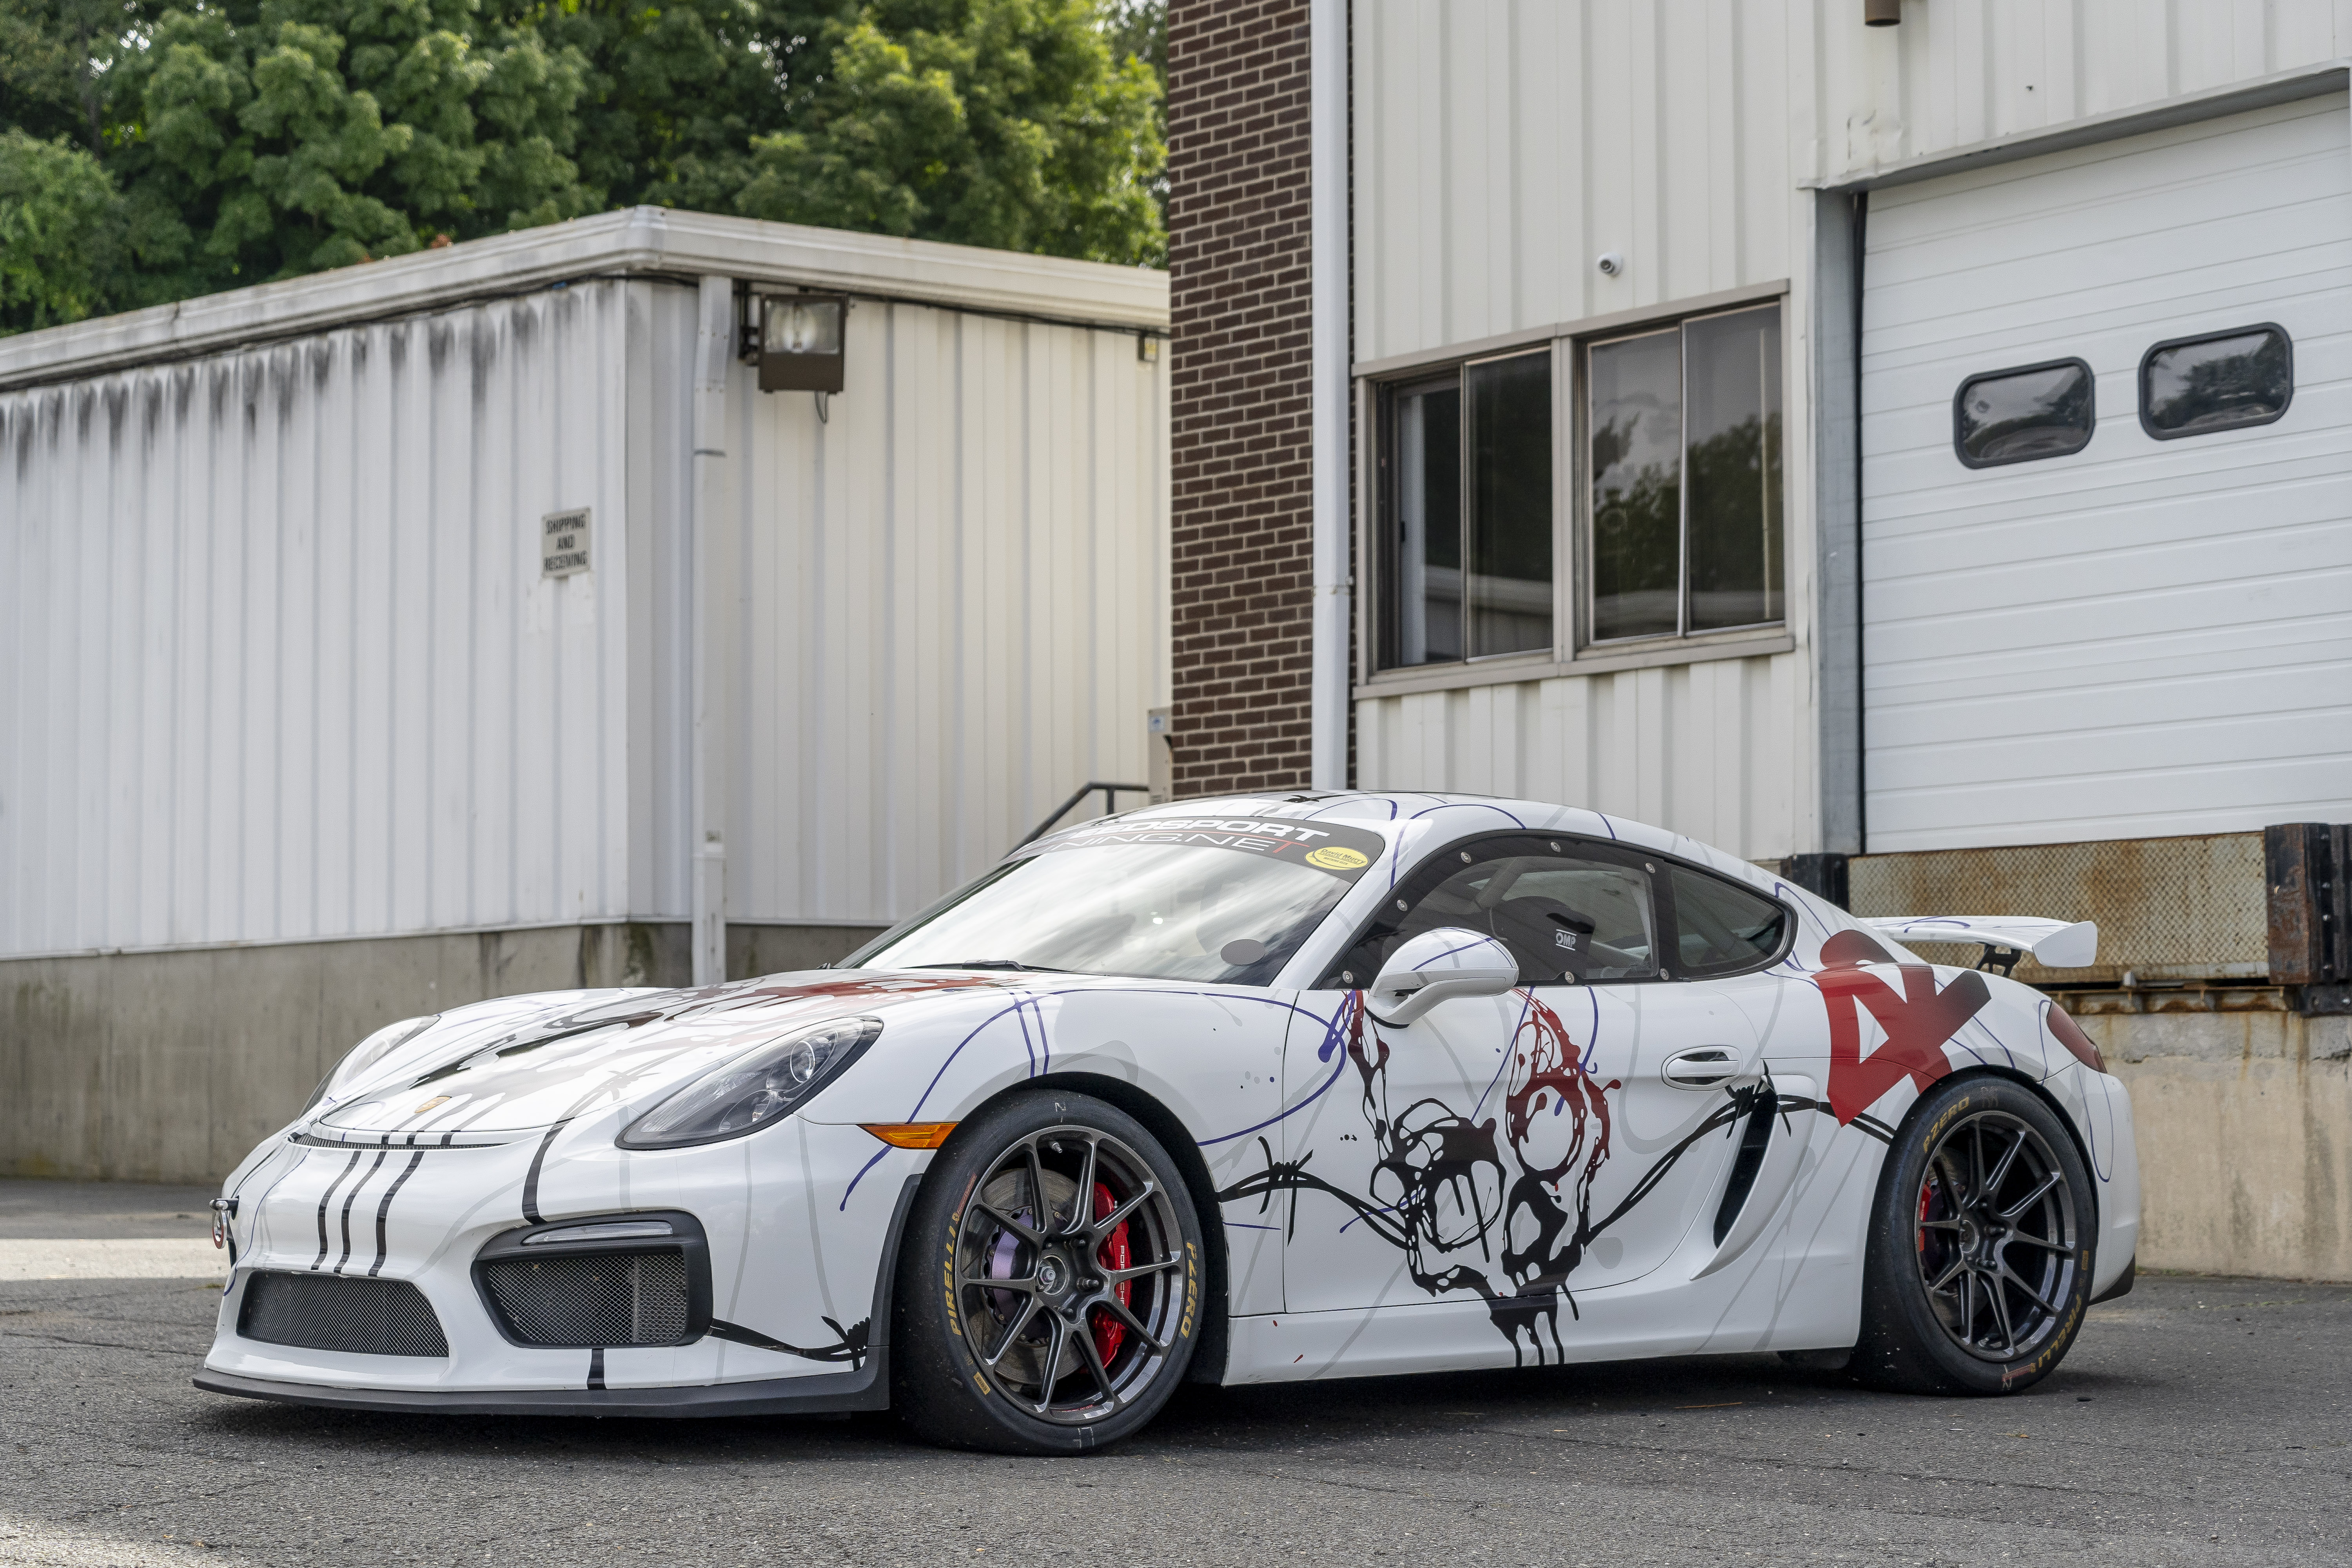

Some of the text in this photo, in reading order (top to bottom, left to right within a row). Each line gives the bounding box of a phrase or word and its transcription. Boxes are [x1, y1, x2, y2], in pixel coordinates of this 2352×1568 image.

[1343, 854, 1366, 864] Murry
[1556, 932, 1576, 947] OMP
[944, 1225, 962, 1336] PIRELLI
[2038, 1294, 2082, 1368] PIRELLI
